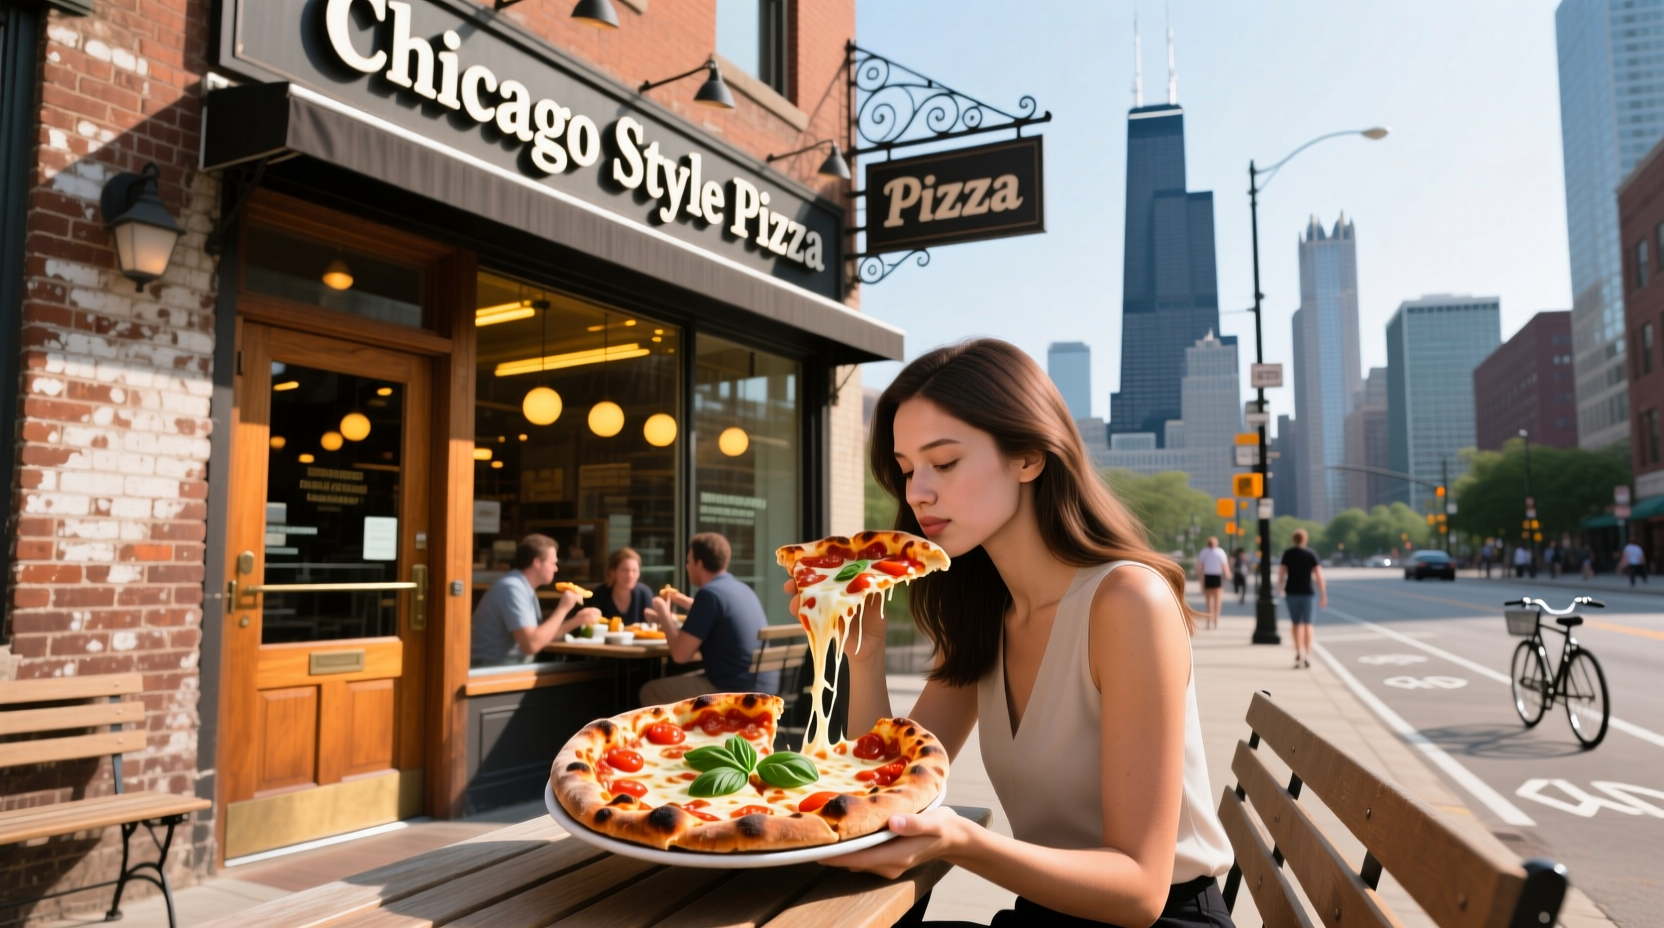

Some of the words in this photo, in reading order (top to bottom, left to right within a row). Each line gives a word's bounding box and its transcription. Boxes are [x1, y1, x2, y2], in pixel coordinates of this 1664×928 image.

[325, 0, 601, 175] Chicago
[613, 116, 724, 224] Style
[730, 176, 826, 272] Pizza
[883, 174, 1024, 228] Pizza
